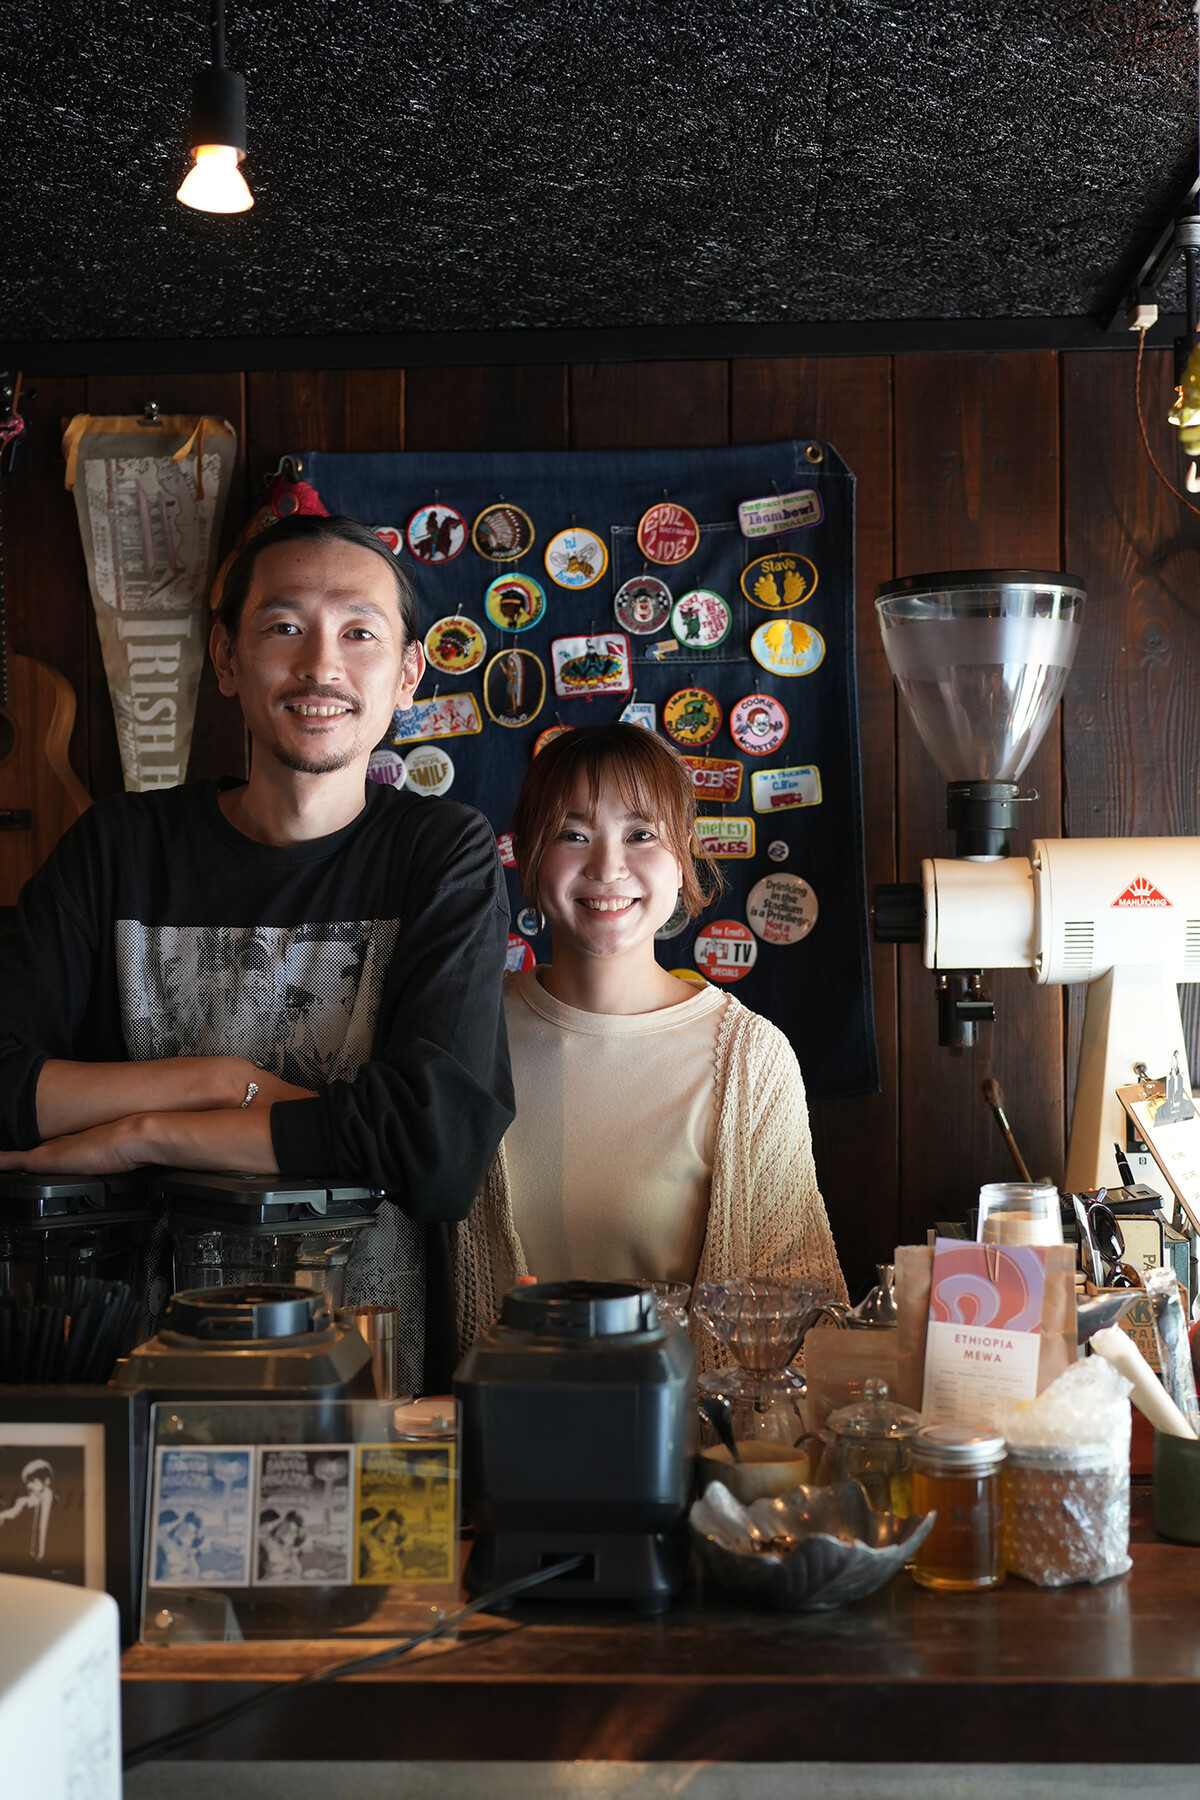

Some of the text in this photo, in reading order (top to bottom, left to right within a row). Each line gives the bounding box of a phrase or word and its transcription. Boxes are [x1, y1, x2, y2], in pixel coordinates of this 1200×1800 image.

[744, 501, 815, 526] Teambowl
[761, 558, 800, 573] Slave
[769, 651, 807, 668] Master
[116, 614, 193, 754] IRISH
[671, 691, 687, 706] MAY
[689, 690, 699, 698] BE
[701, 692, 714, 706] OLD
[741, 697, 776, 711] COOKIE
[632, 705, 652, 713] STATE
[498, 713, 528, 725] NAVAJO
[738, 735, 779, 753] MONSTER
[408, 762, 448, 787] SMILE
[691, 769, 724, 787] CB
[766, 880, 807, 897] Drinking
[782, 892, 798, 903] the
[1118, 897, 1167, 907] MAHLKÖNIG
[751, 906, 758, 916] is
[759, 909, 765, 917] a
[763, 898, 803, 914] Stadium
[766, 920, 791, 932] Not a
[734, 943, 752, 963] TV
[711, 967, 739, 978] SPECIALS
[954, 1333, 1014, 1350] ETHIOPIA
[963, 1350, 1002, 1364] MEWA
